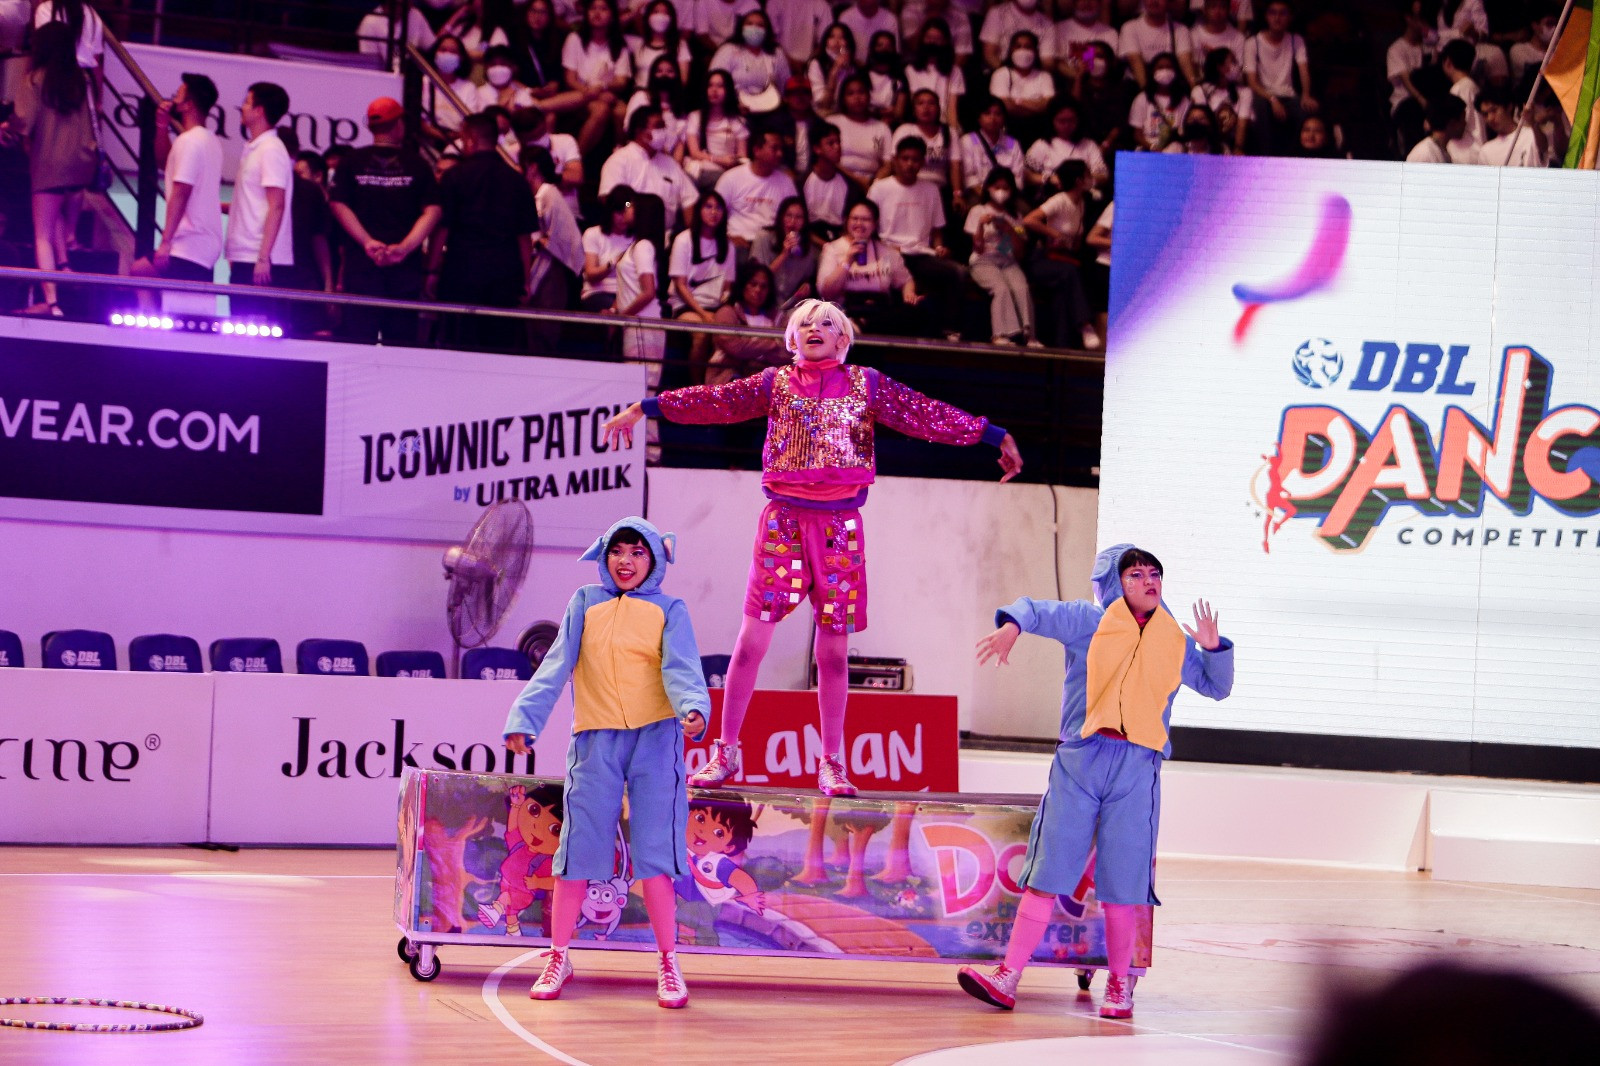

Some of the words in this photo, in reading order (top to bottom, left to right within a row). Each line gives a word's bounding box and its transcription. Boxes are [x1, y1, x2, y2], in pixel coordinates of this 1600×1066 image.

[1348, 340, 1476, 396] DBL
[453, 485, 471, 503] by
[475, 475, 560, 507] ULTRA
[565, 463, 632, 496] MILK
[281, 716, 536, 779] Jackson
